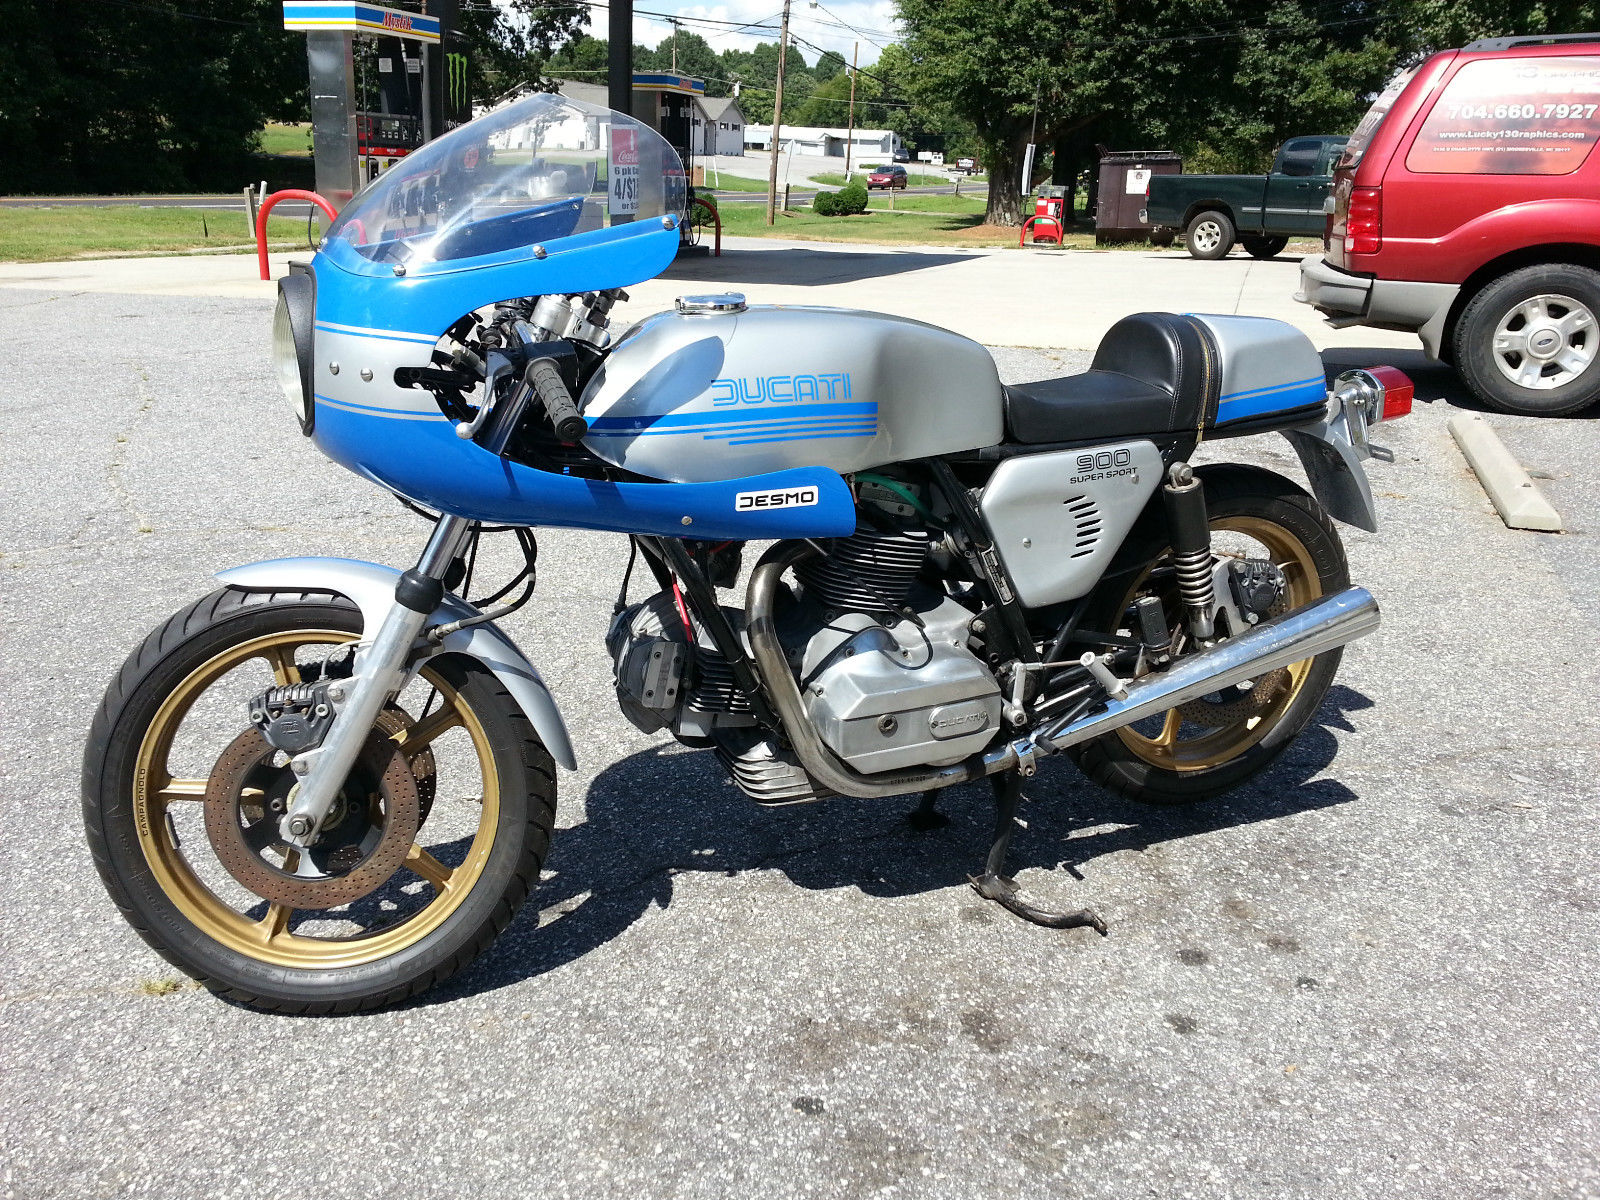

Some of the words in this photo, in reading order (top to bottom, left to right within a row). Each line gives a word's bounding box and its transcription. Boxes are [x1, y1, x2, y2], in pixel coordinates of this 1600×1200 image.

[382, 11, 413, 31] Mystik
[1448, 103, 1598, 119] 704.660.7927
[1439, 130, 1585, 139] www.Lucky13Graphics.com
[711, 373, 852, 407] DUCATI
[1076, 449, 1131, 473] 900
[1070, 473, 1104, 484] SUPER
[1106, 467, 1138, 478] SPORT
[740, 491, 814, 508] DESMO
[939, 712, 980, 728] DUCATI
[138, 768, 149, 837] CAMPAGNOLO
